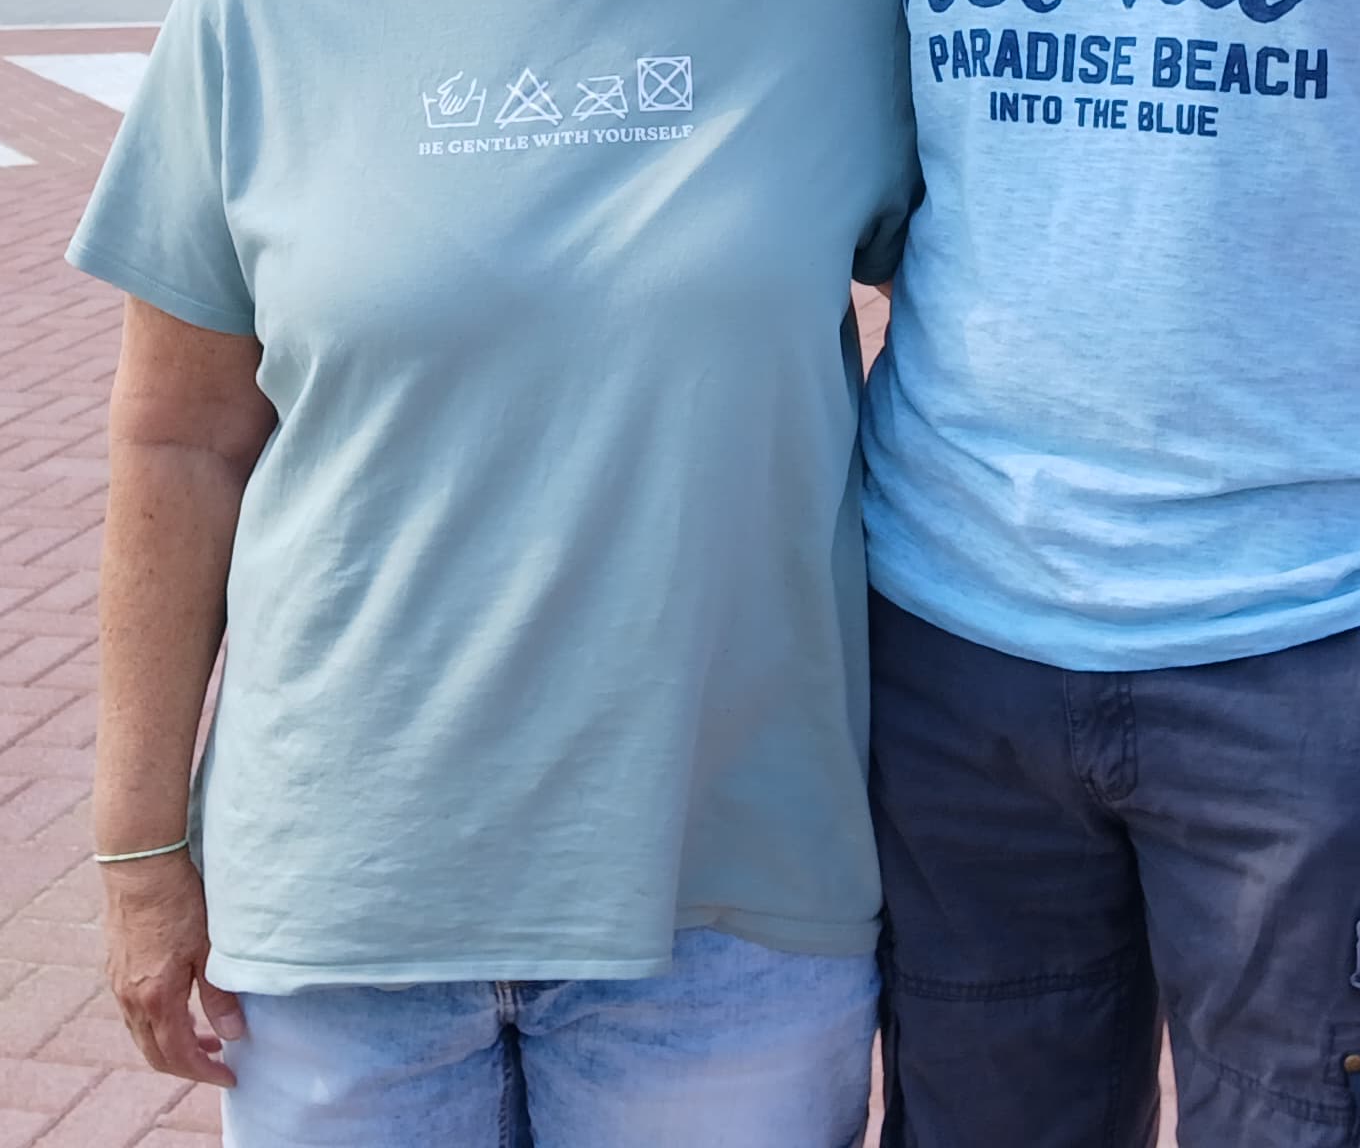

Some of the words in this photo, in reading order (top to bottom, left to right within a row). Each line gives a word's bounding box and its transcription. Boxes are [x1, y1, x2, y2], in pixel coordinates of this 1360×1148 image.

[929, 28, 1137, 86] PARADISE
[1152, 37, 1328, 100] BEACH
[990, 91, 1062, 125] INTO
[1074, 98, 1127, 130] THE
[1138, 101, 1219, 137] BLUE
[418, 141, 444, 156] BE
[447, 134, 529, 155] GENTLE
[532, 129, 589, 148] WITH
[592, 124, 695, 144] YOURSELF
